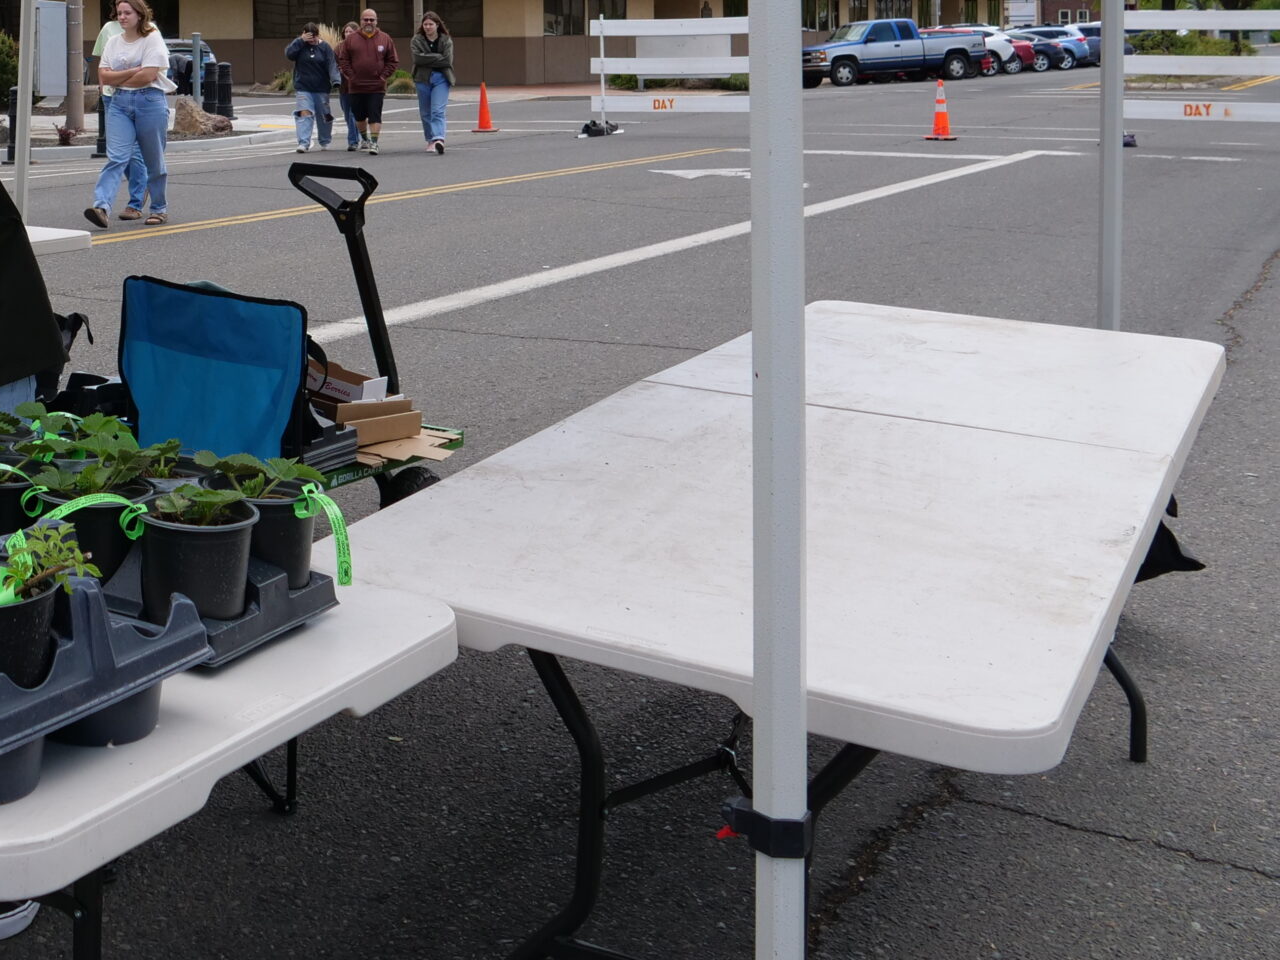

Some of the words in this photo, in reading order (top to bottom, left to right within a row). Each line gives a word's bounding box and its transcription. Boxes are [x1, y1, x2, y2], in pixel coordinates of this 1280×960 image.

[653, 98, 674, 110] DAY
[1184, 103, 1212, 116] DAY
[324, 381, 351, 398] Berries
[338, 470, 363, 483] GORILLA
